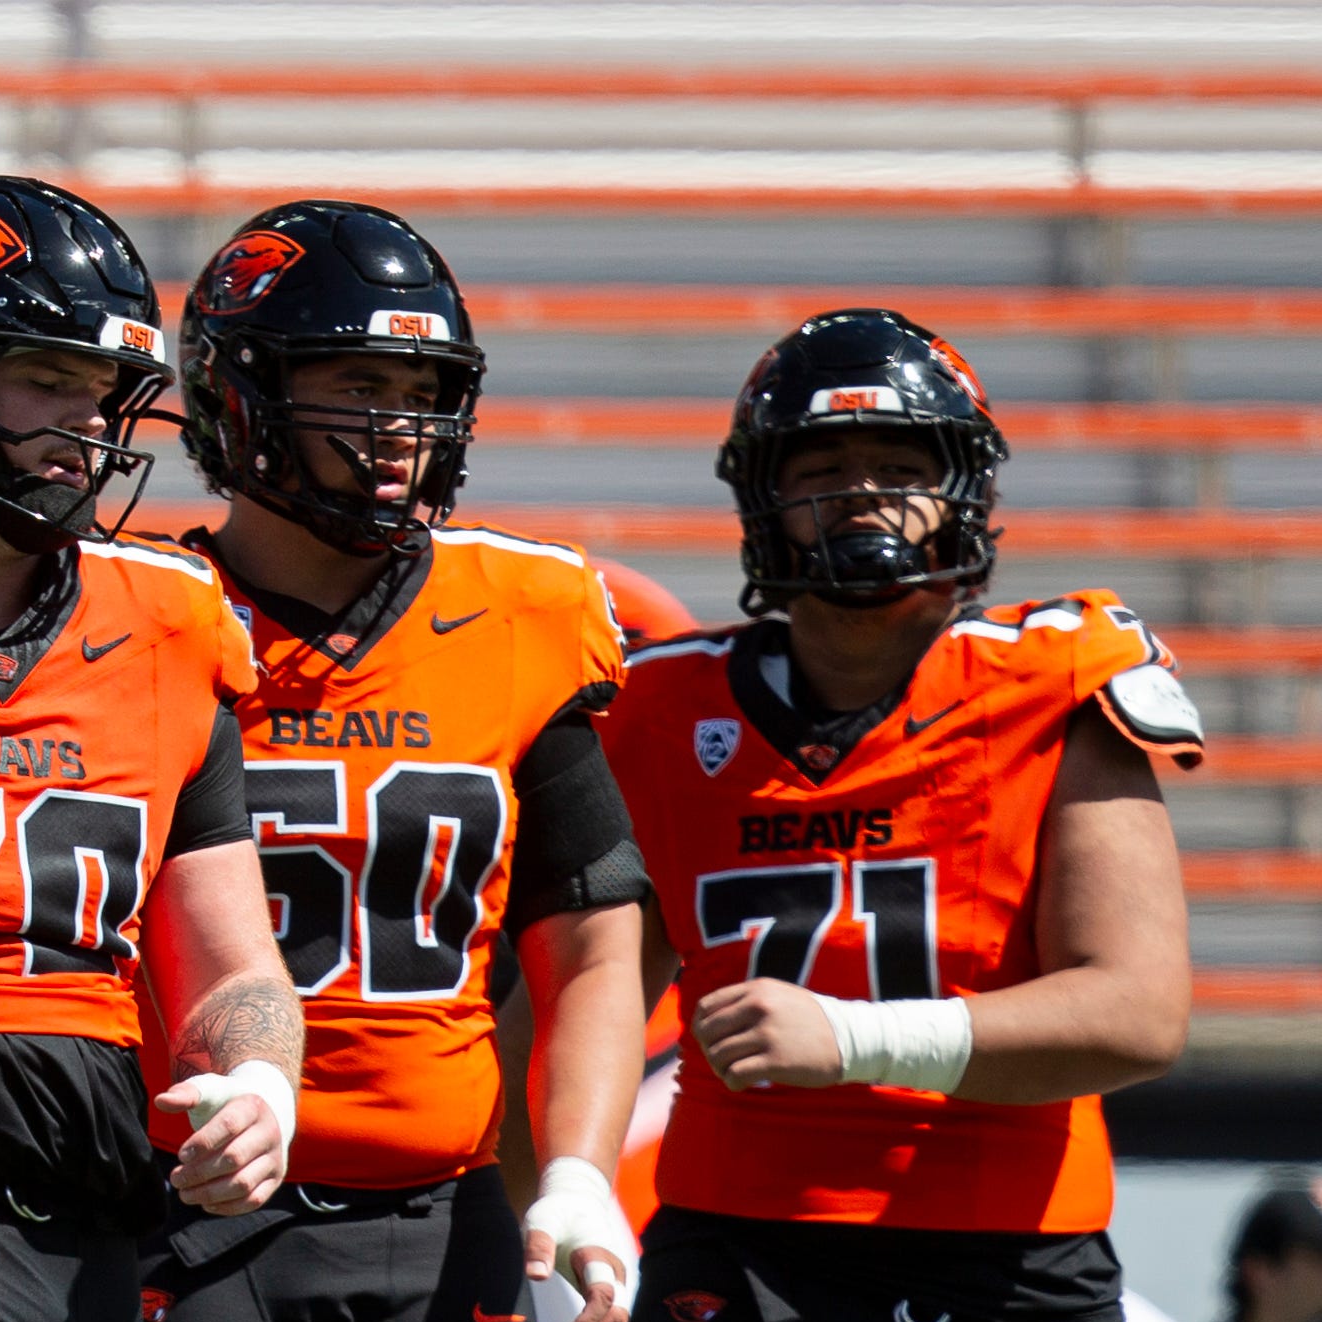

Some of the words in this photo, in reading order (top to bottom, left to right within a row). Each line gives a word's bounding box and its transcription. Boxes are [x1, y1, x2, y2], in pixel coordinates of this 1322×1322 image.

[389, 313, 432, 337] OSU
[828, 390, 878, 411] OSU
[268, 707, 433, 748] BEAVS
[737, 808, 894, 852] BEAVS
[695, 856, 939, 1002] 71
